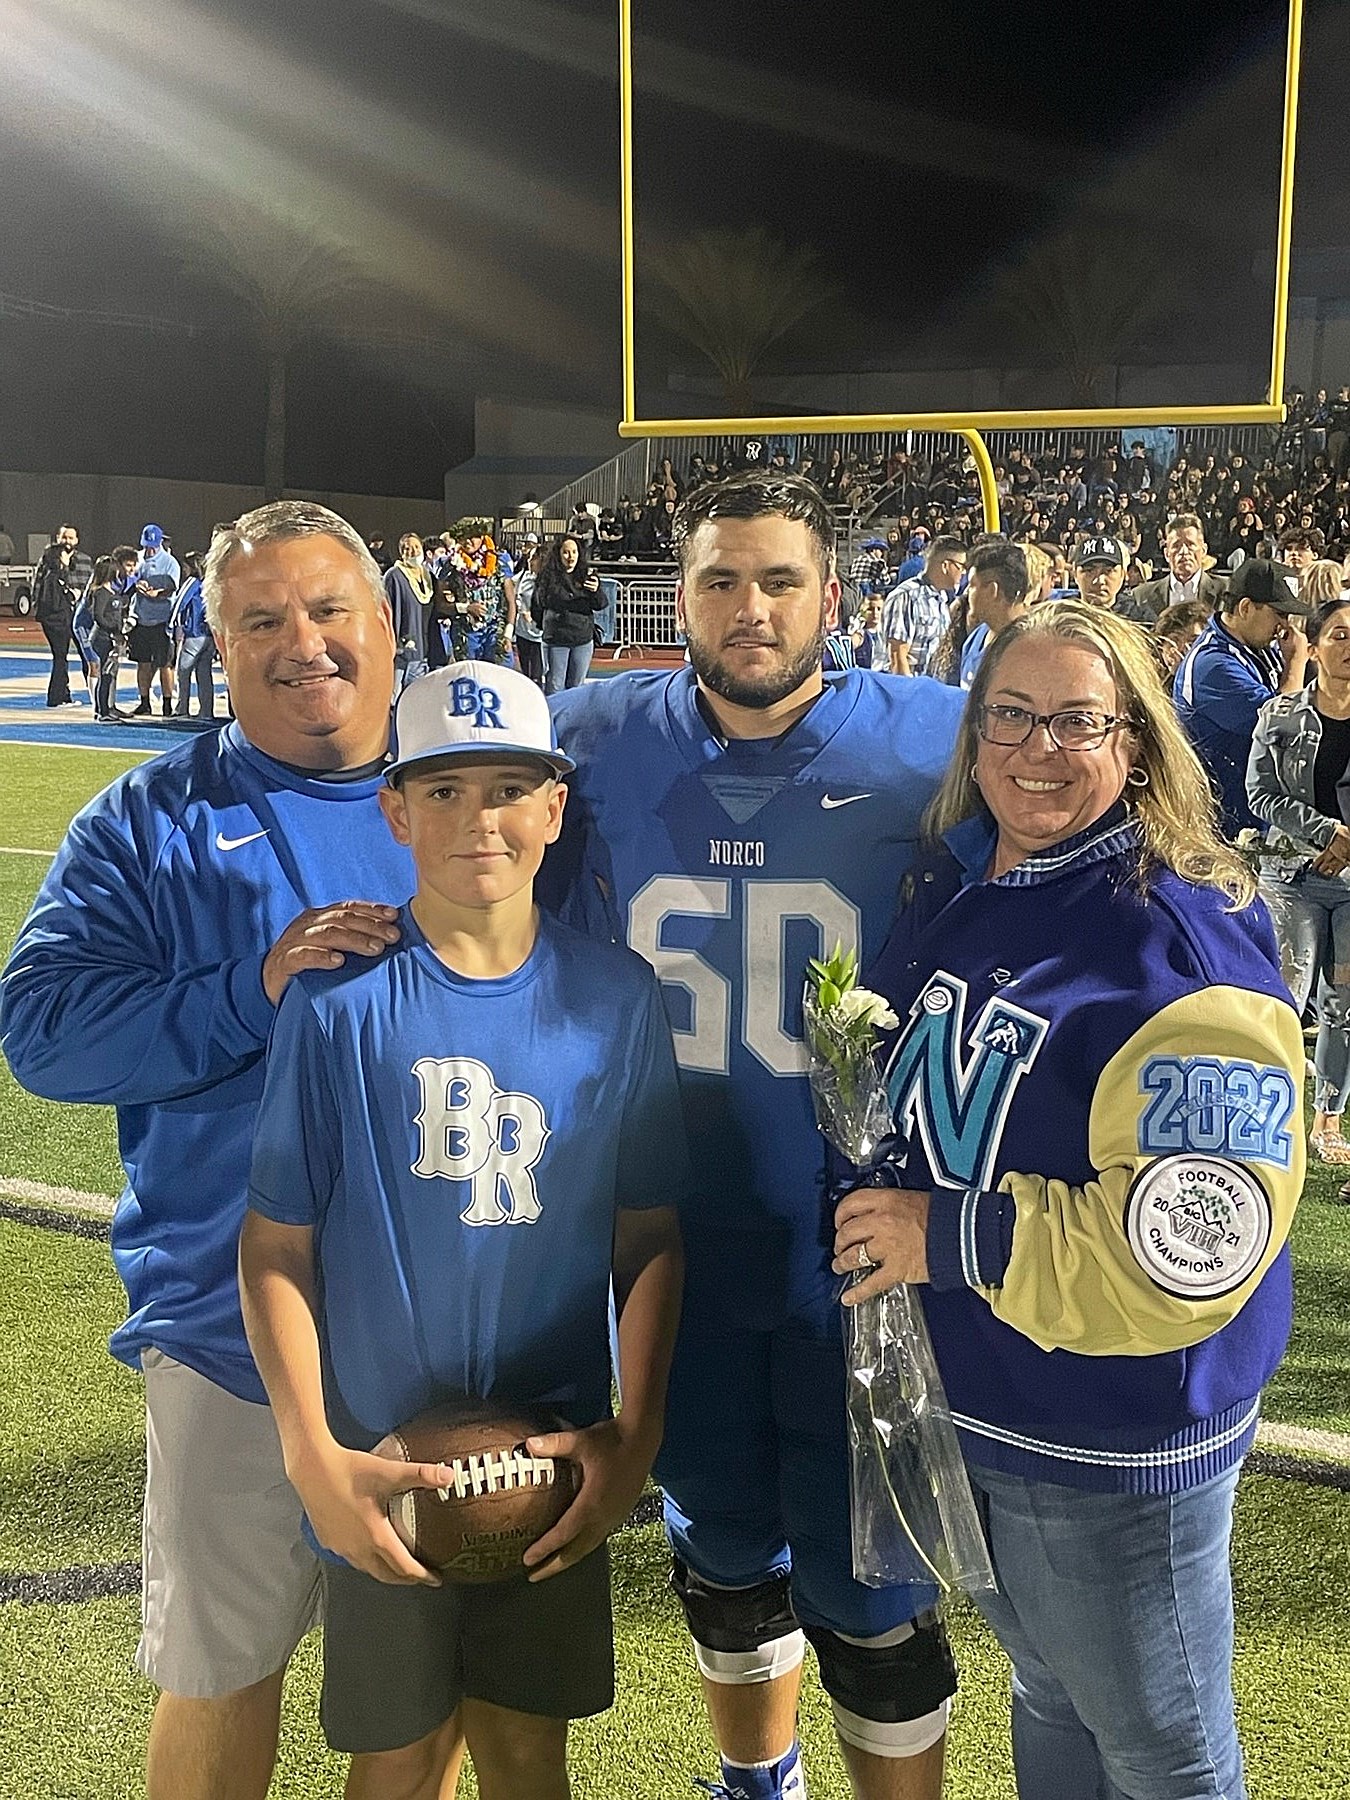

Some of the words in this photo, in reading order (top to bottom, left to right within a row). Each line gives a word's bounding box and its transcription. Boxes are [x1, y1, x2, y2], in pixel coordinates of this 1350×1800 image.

[447, 676, 508, 730] BR
[708, 839, 765, 867] NORCO
[1137, 1055, 1296, 1171] 2022
[409, 1056, 553, 1227] BR
[1152, 1196, 1169, 1213] 20
[1177, 1170, 1246, 1213] FOOTBALL
[1149, 1227, 1224, 1273] CHAMPIONS
[1225, 1232, 1241, 1247] 21
